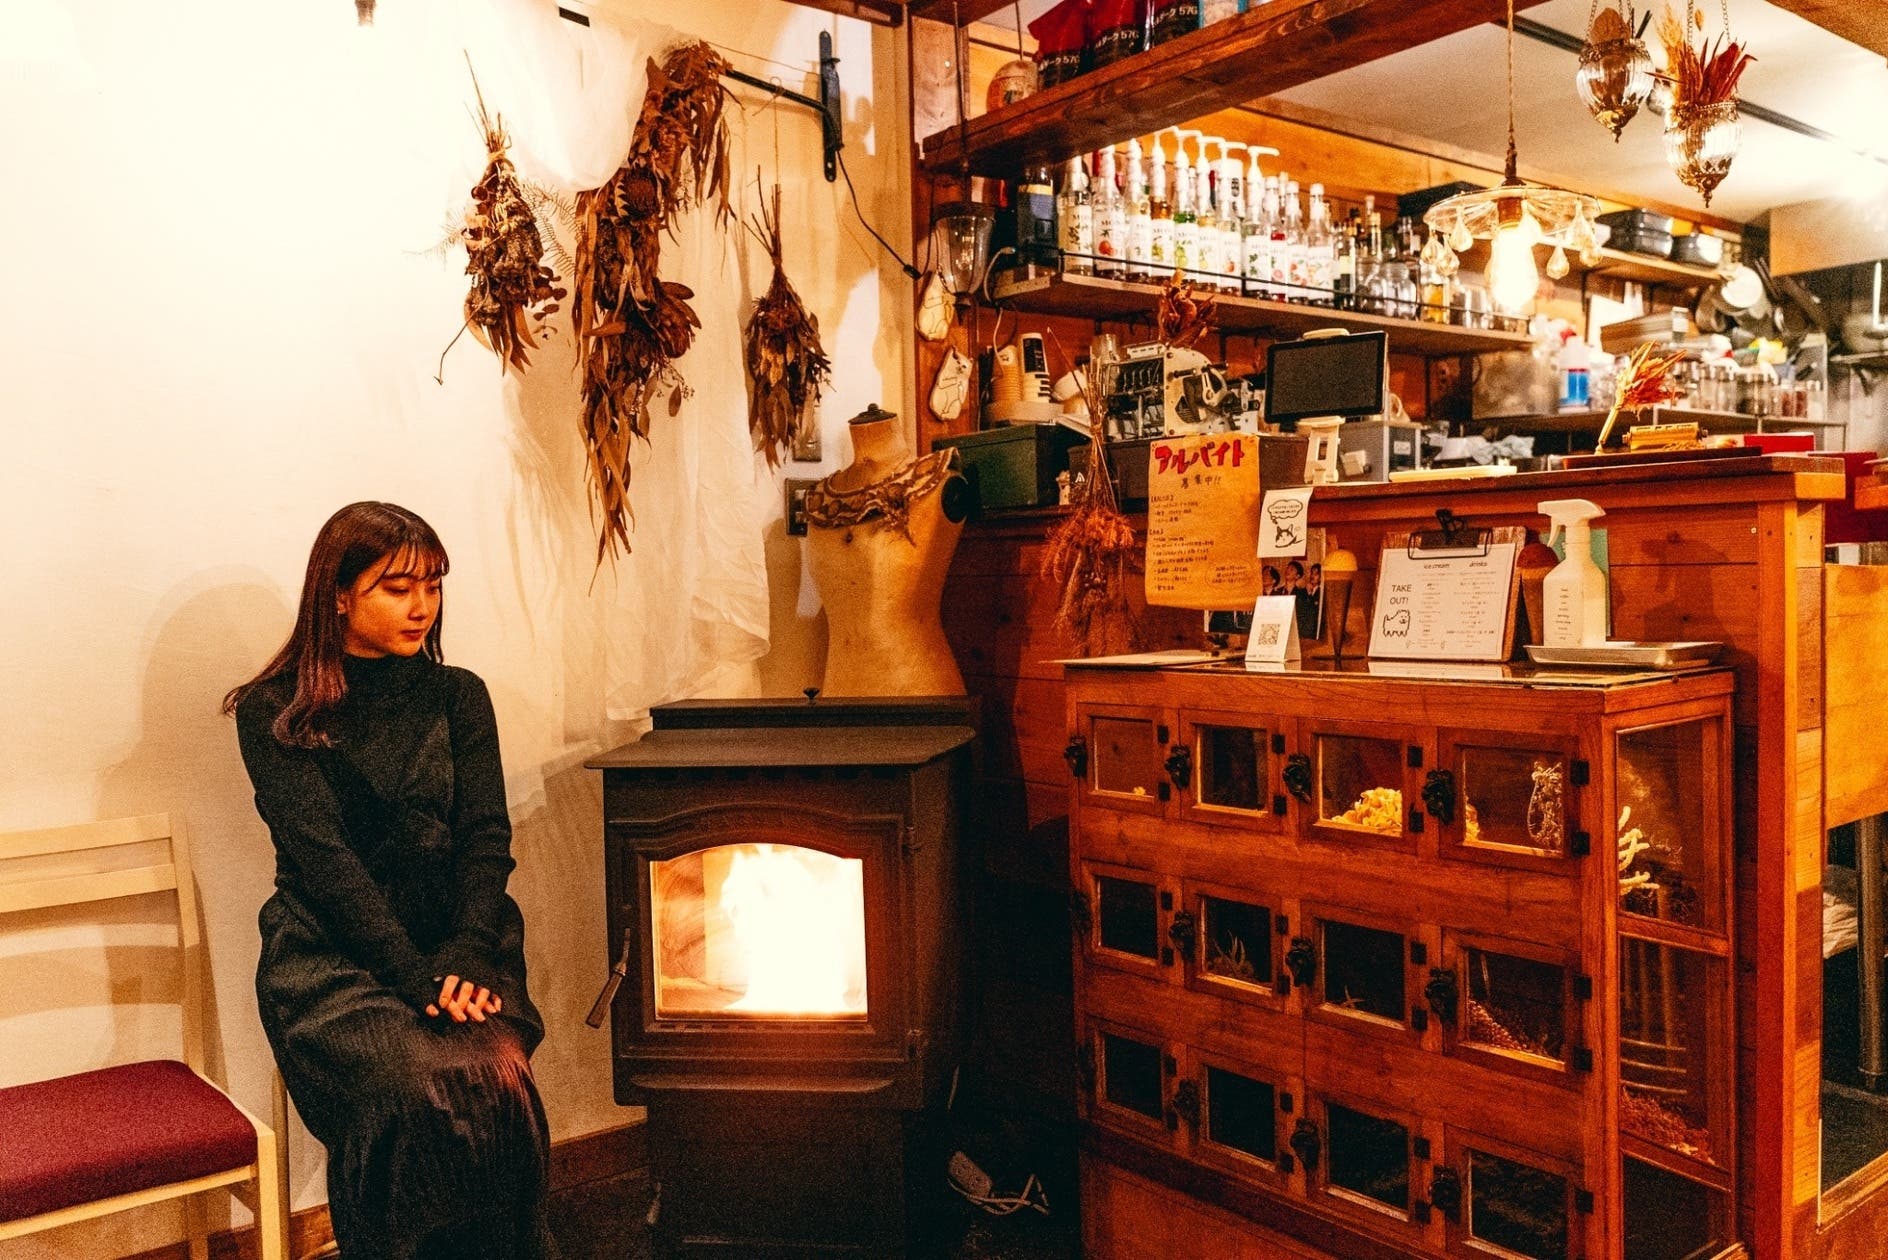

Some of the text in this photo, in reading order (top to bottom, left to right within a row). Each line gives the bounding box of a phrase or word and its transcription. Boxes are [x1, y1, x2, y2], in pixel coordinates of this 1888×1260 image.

[1155, 439, 1245, 475] アルバイト
[1391, 584, 1412, 592] TAKE
